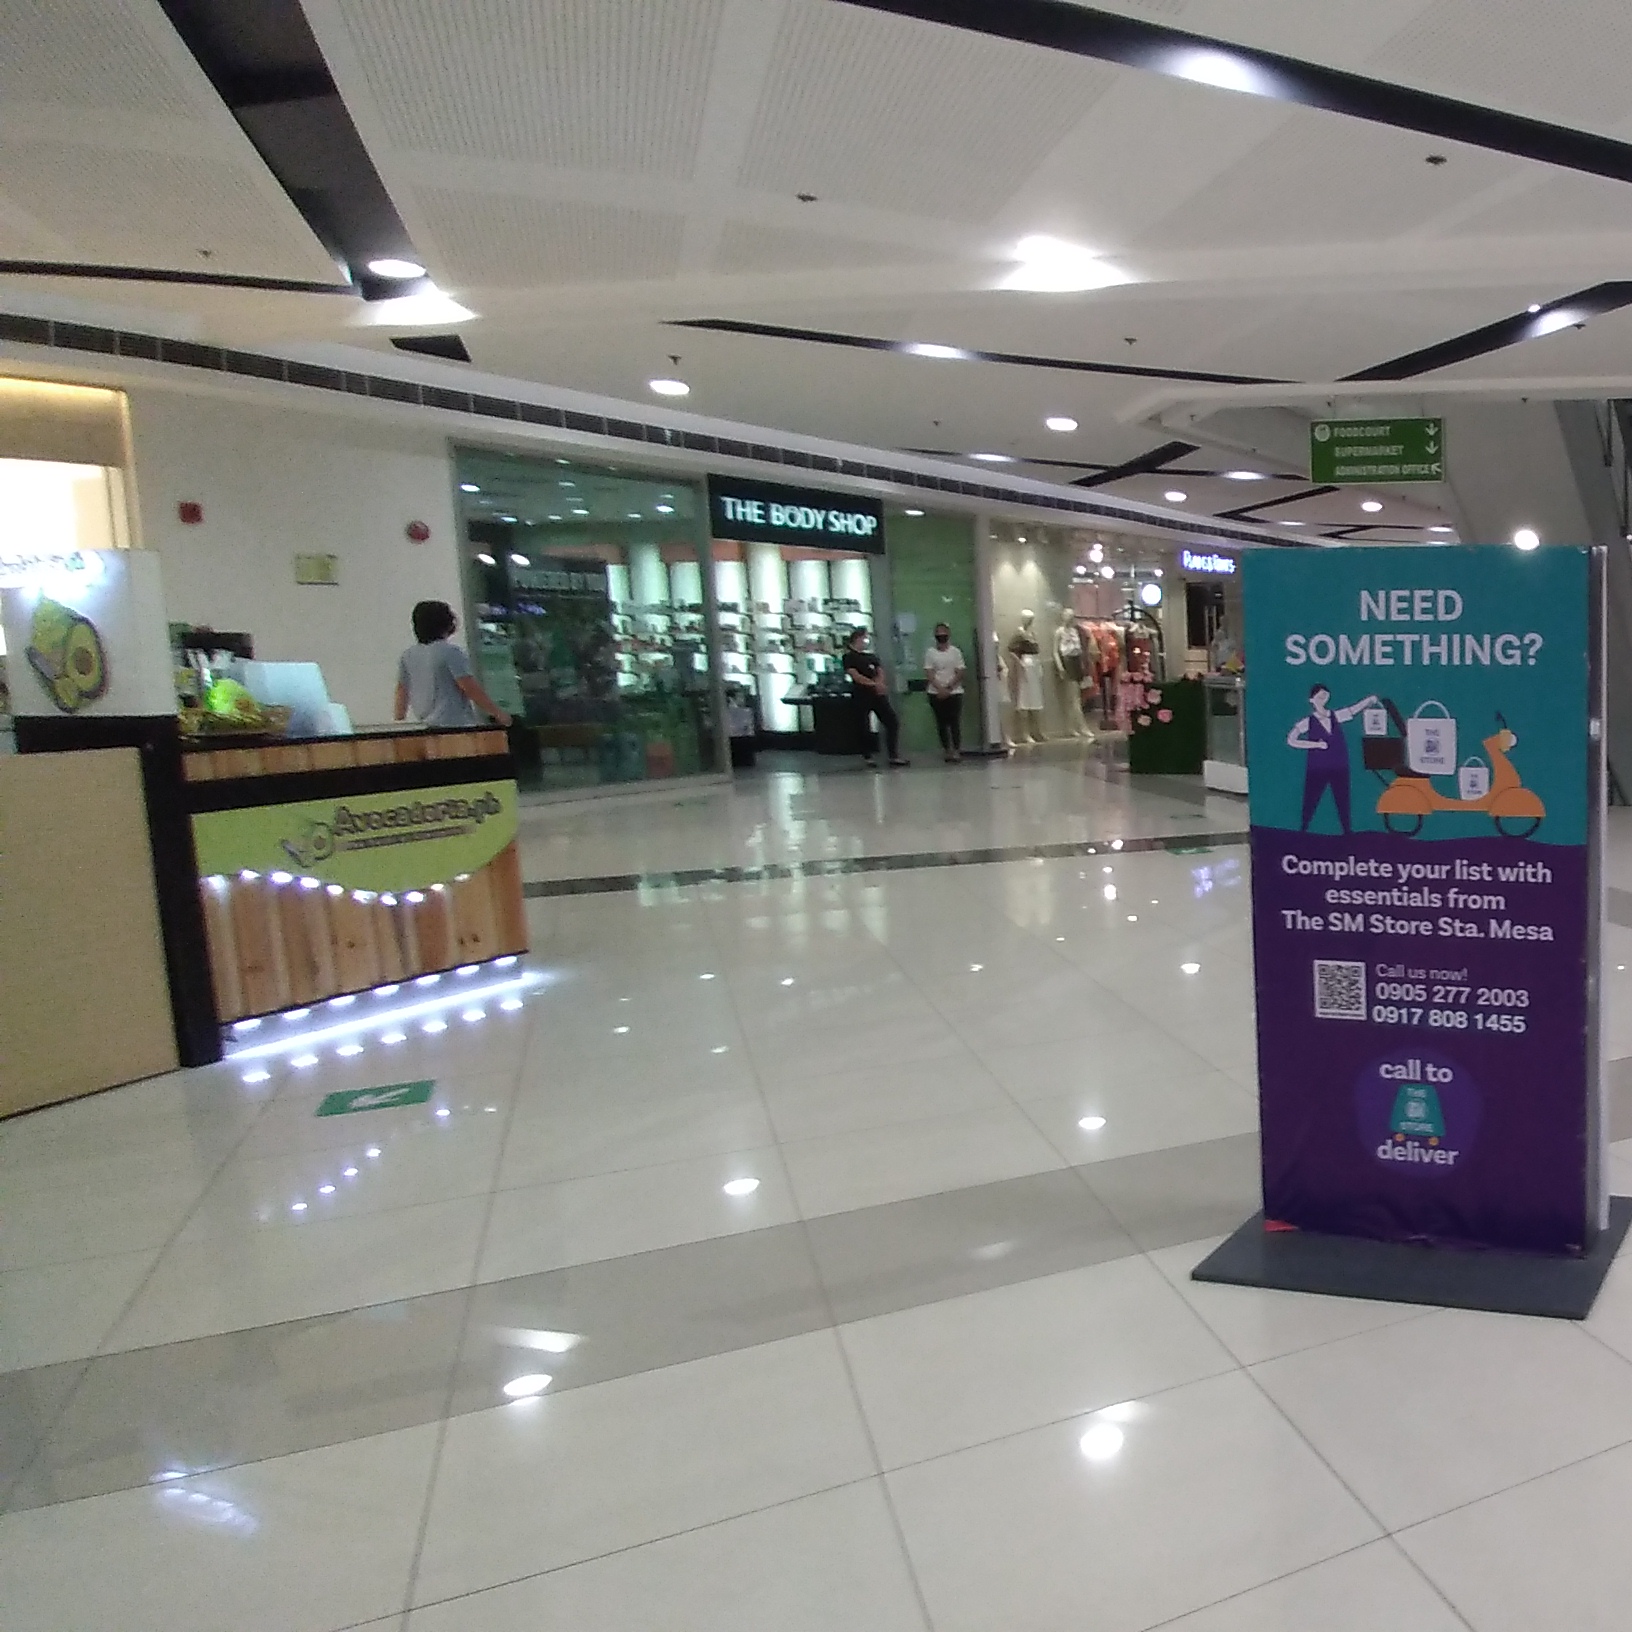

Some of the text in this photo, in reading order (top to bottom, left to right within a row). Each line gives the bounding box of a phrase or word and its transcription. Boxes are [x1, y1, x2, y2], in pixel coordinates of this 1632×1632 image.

[1334, 426, 1391, 438] FOODCOURT
[1334, 445, 1404, 457] SUPERMARKET
[1335, 464, 1430, 476] ADMINISTRATION OFFICE
[720, 496, 878, 536] THE BODY SHOP
[1359, 589, 1464, 622] NEED
[1285, 632, 1544, 666] SOMETHING?
[1281, 855, 1553, 883] Complete your list with
[1324, 887, 1506, 910] essentials from
[1281, 910, 1555, 941] The SM Store Sta. Mesa
[1375, 963, 1469, 982] Call us now!
[1375, 982, 1530, 1007] 0905 277 2003
[1372, 1005, 1527, 1033] 0917 808 1455
[1379, 1059, 1454, 1083] call to
[1377, 1139, 1460, 1165] deliver
